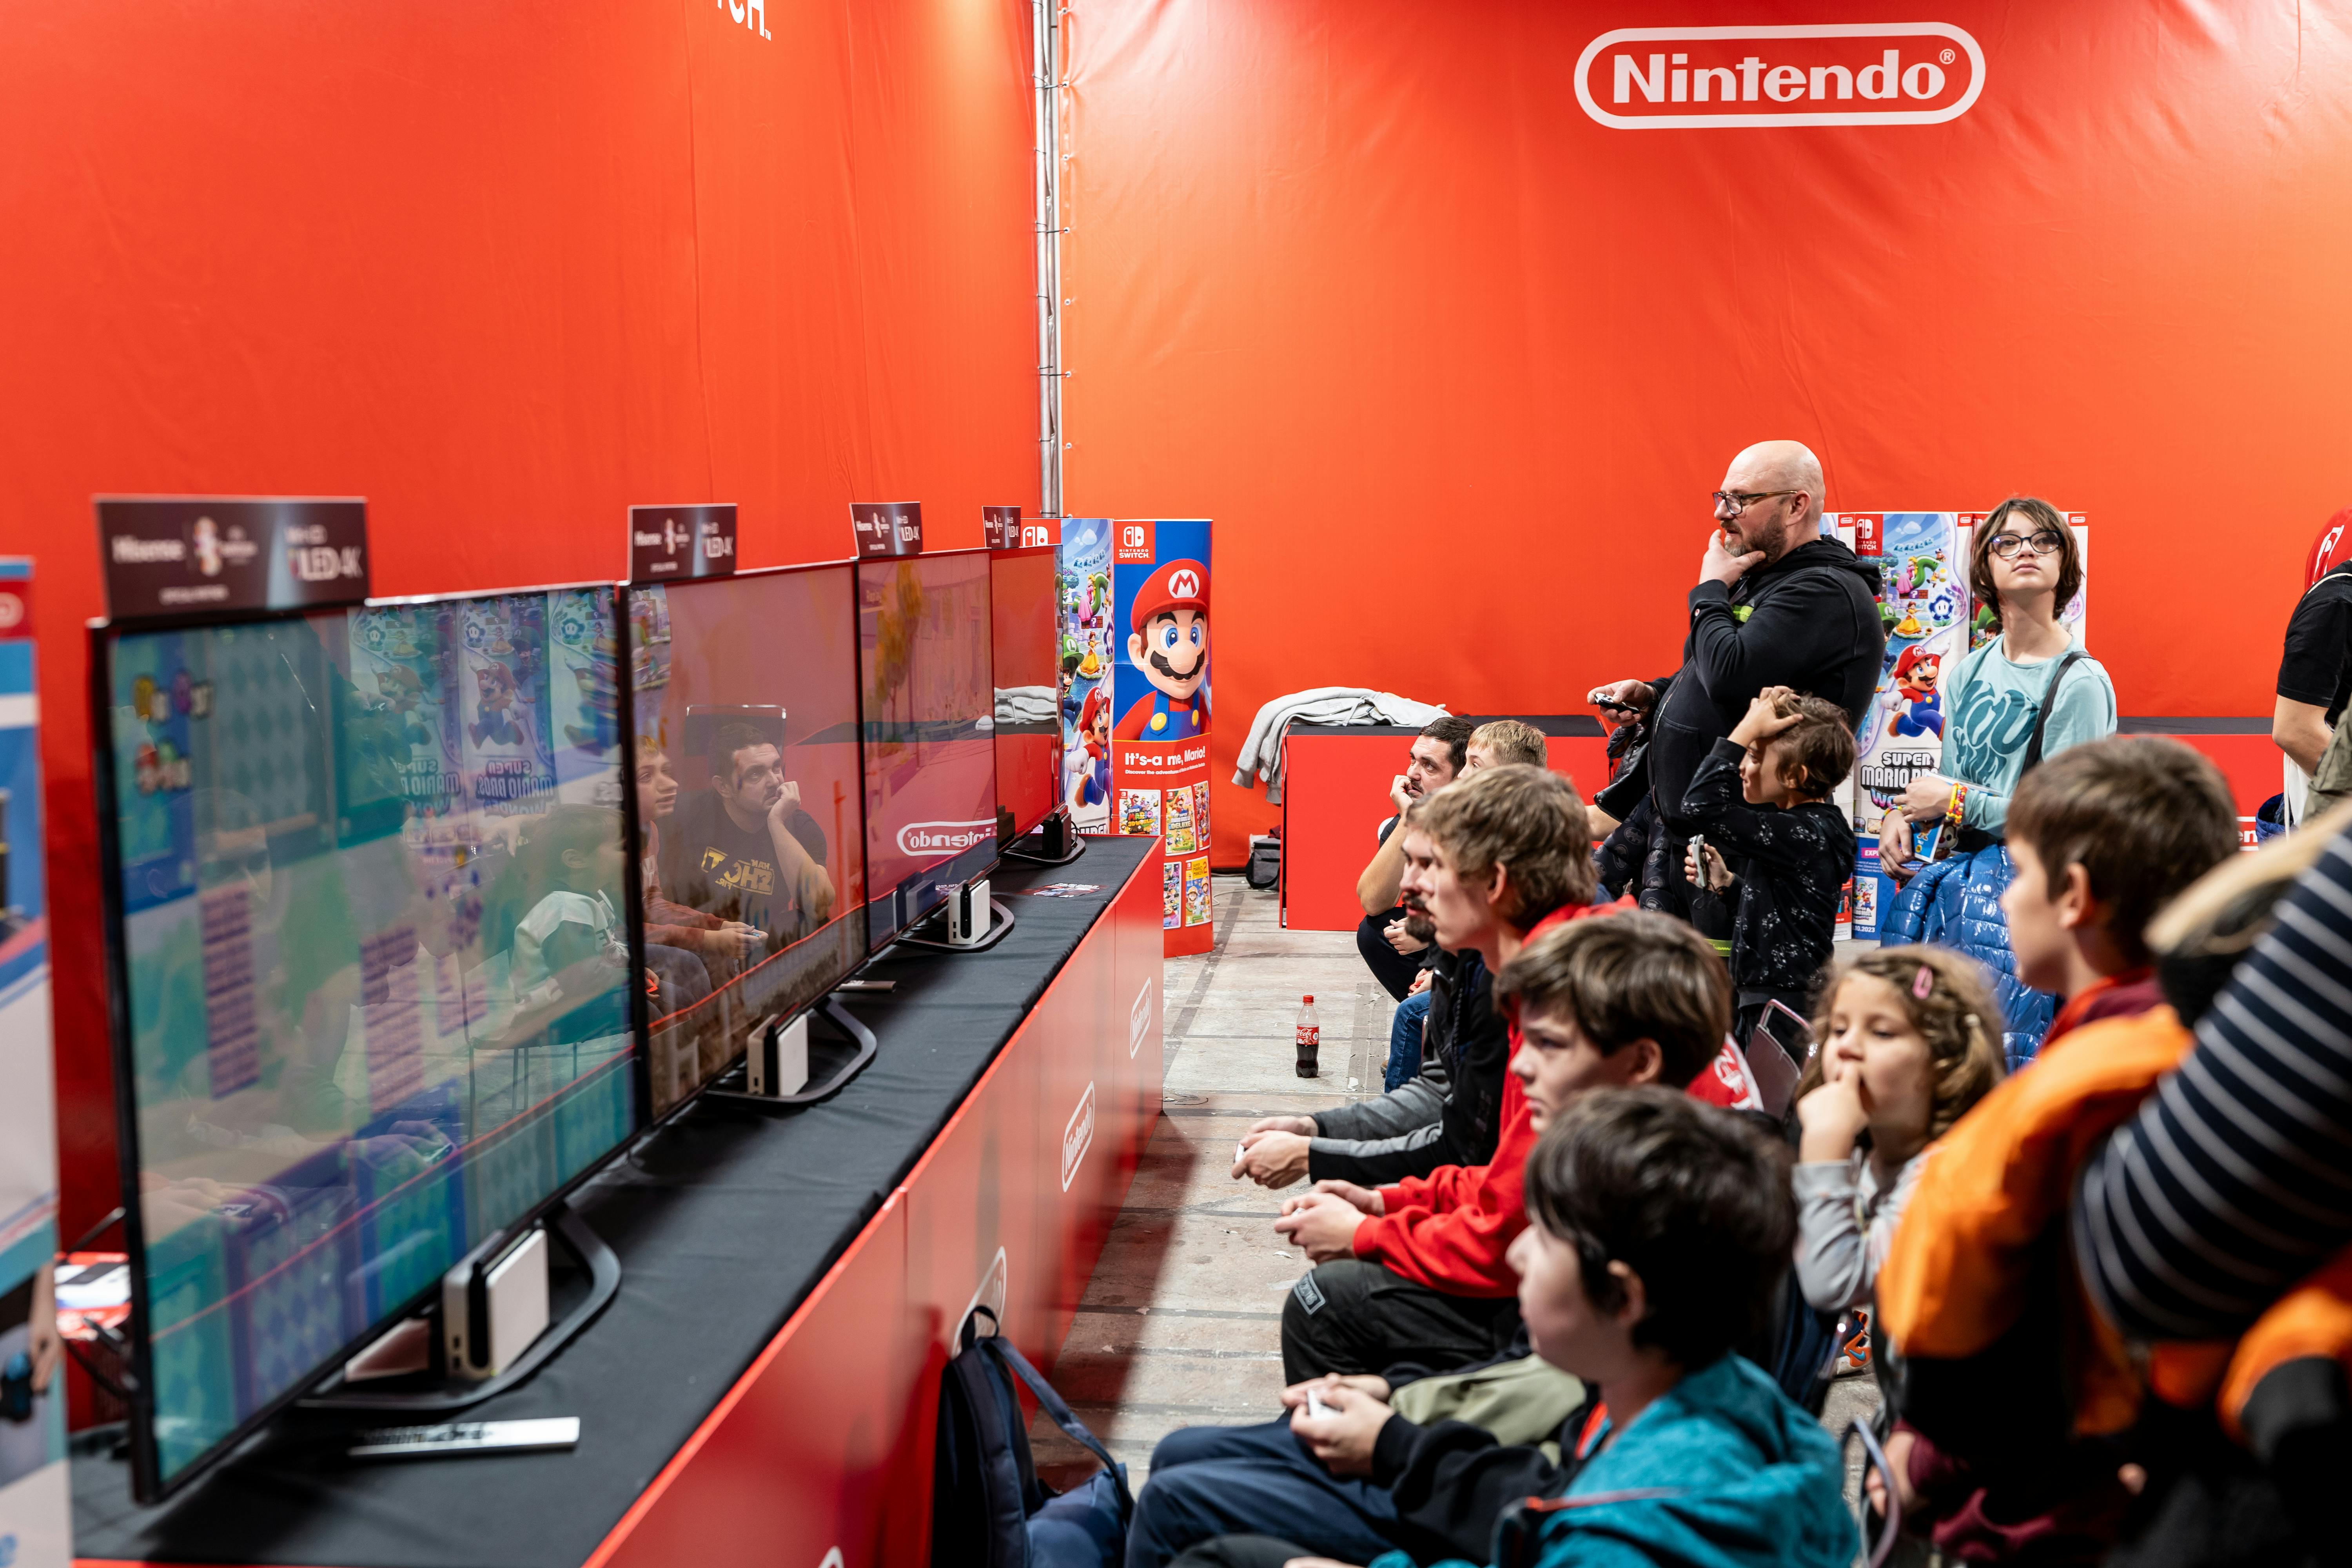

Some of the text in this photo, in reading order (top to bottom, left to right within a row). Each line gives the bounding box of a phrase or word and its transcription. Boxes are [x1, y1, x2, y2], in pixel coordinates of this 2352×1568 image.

[1167, 754, 1183, 766] me,
[1184, 746, 1205, 762] Mario!
[1882, 752, 1931, 766] SUPER
[1862, 765, 1909, 788] MARIO
